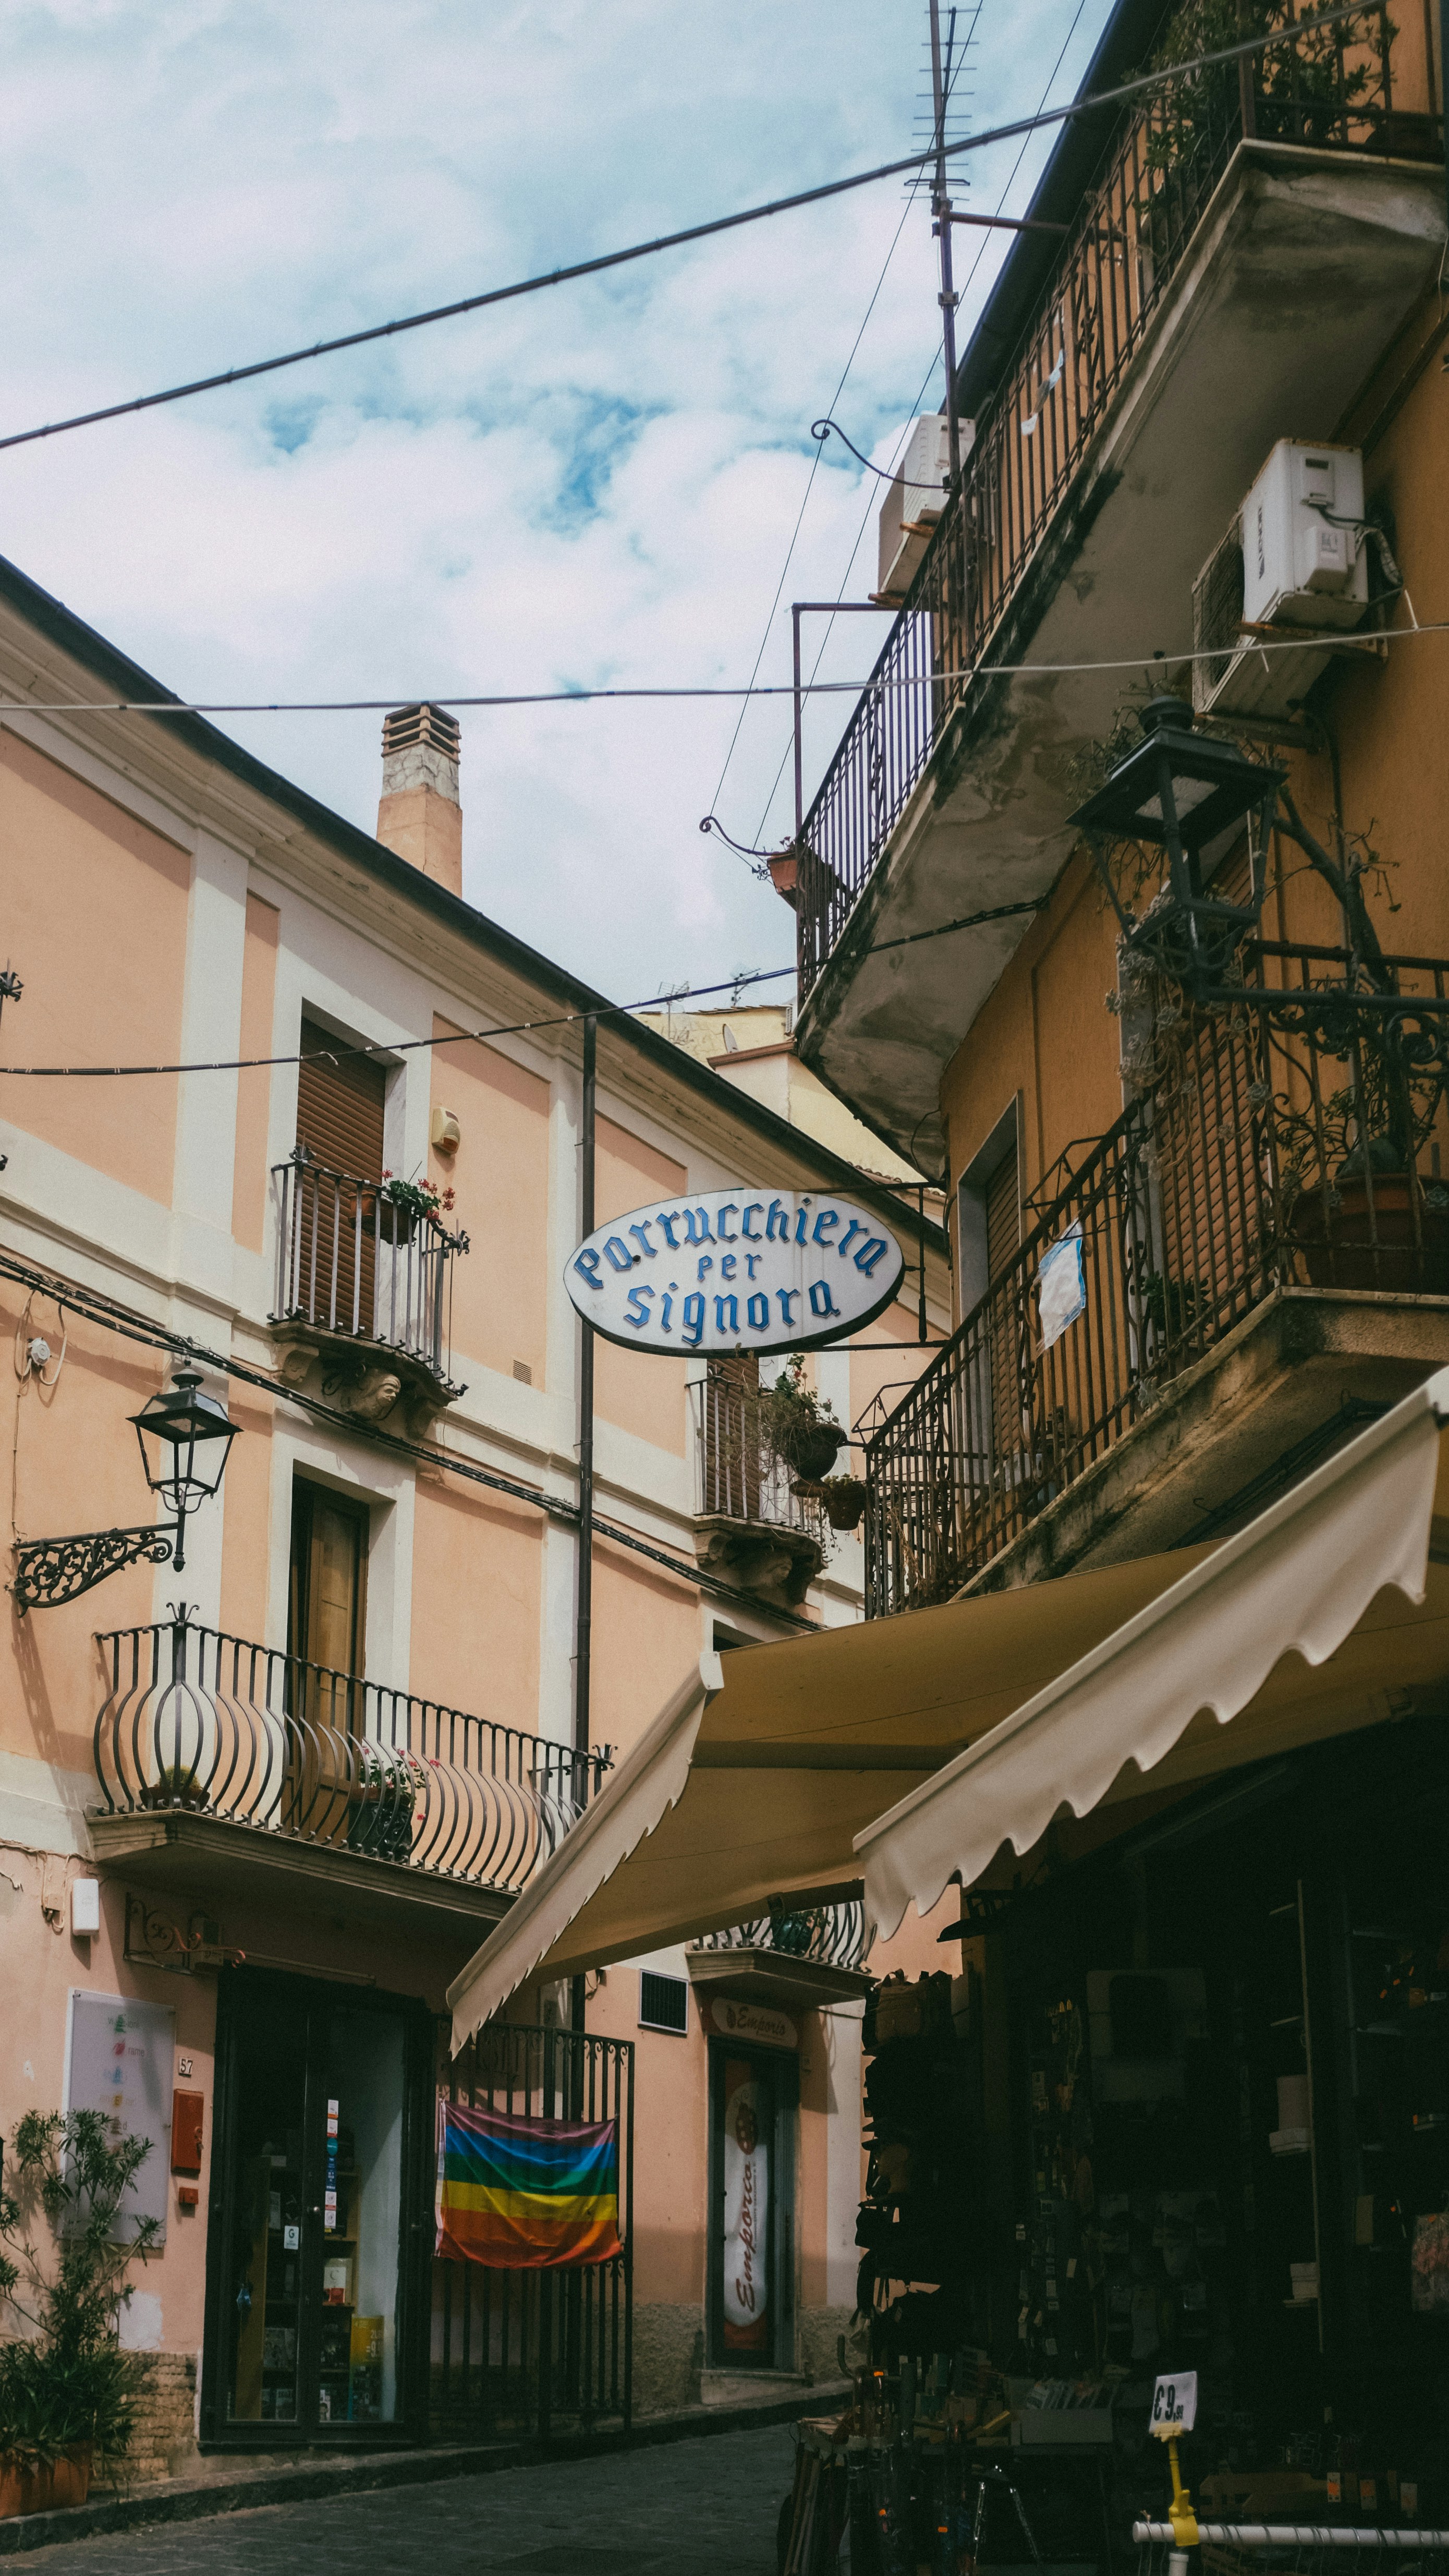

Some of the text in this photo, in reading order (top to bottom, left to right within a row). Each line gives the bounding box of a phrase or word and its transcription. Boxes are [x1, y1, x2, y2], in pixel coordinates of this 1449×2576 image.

[697, 1253, 763, 1281] per
[623, 1279, 841, 1346] Signora
[737, 2006, 785, 2036] Emporio
[180, 2058, 193, 2074] 57
[736, 2161, 756, 2313] Emporio
